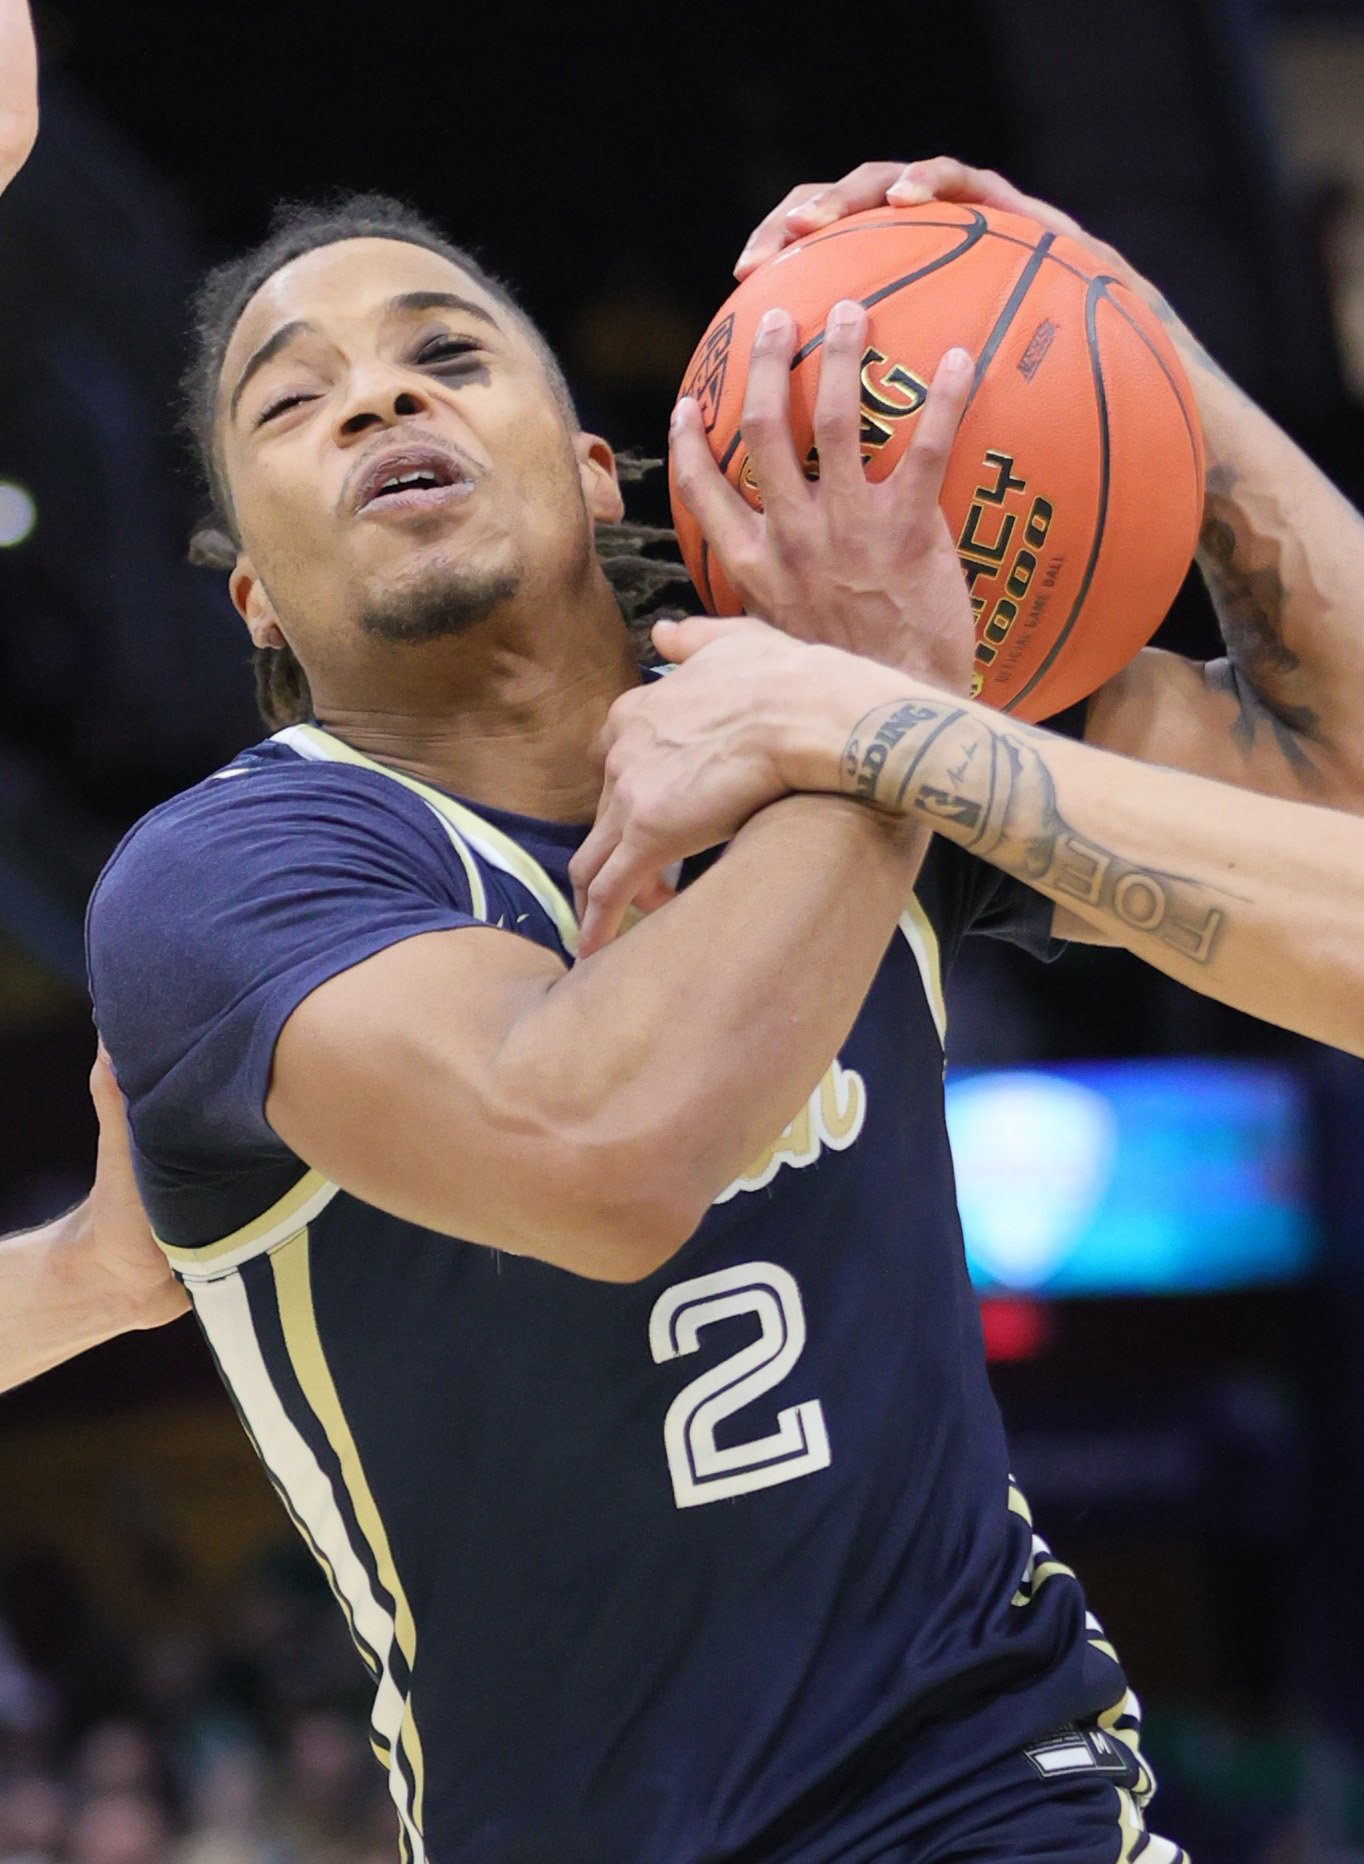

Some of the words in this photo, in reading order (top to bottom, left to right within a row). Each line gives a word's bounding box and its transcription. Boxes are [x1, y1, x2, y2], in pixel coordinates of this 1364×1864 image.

[1041, 555, 1064, 588] BALL
[1053, 834, 1224, 967] FOE
[649, 1261, 831, 1510] 2
[1088, 1731, 1112, 1755] M
